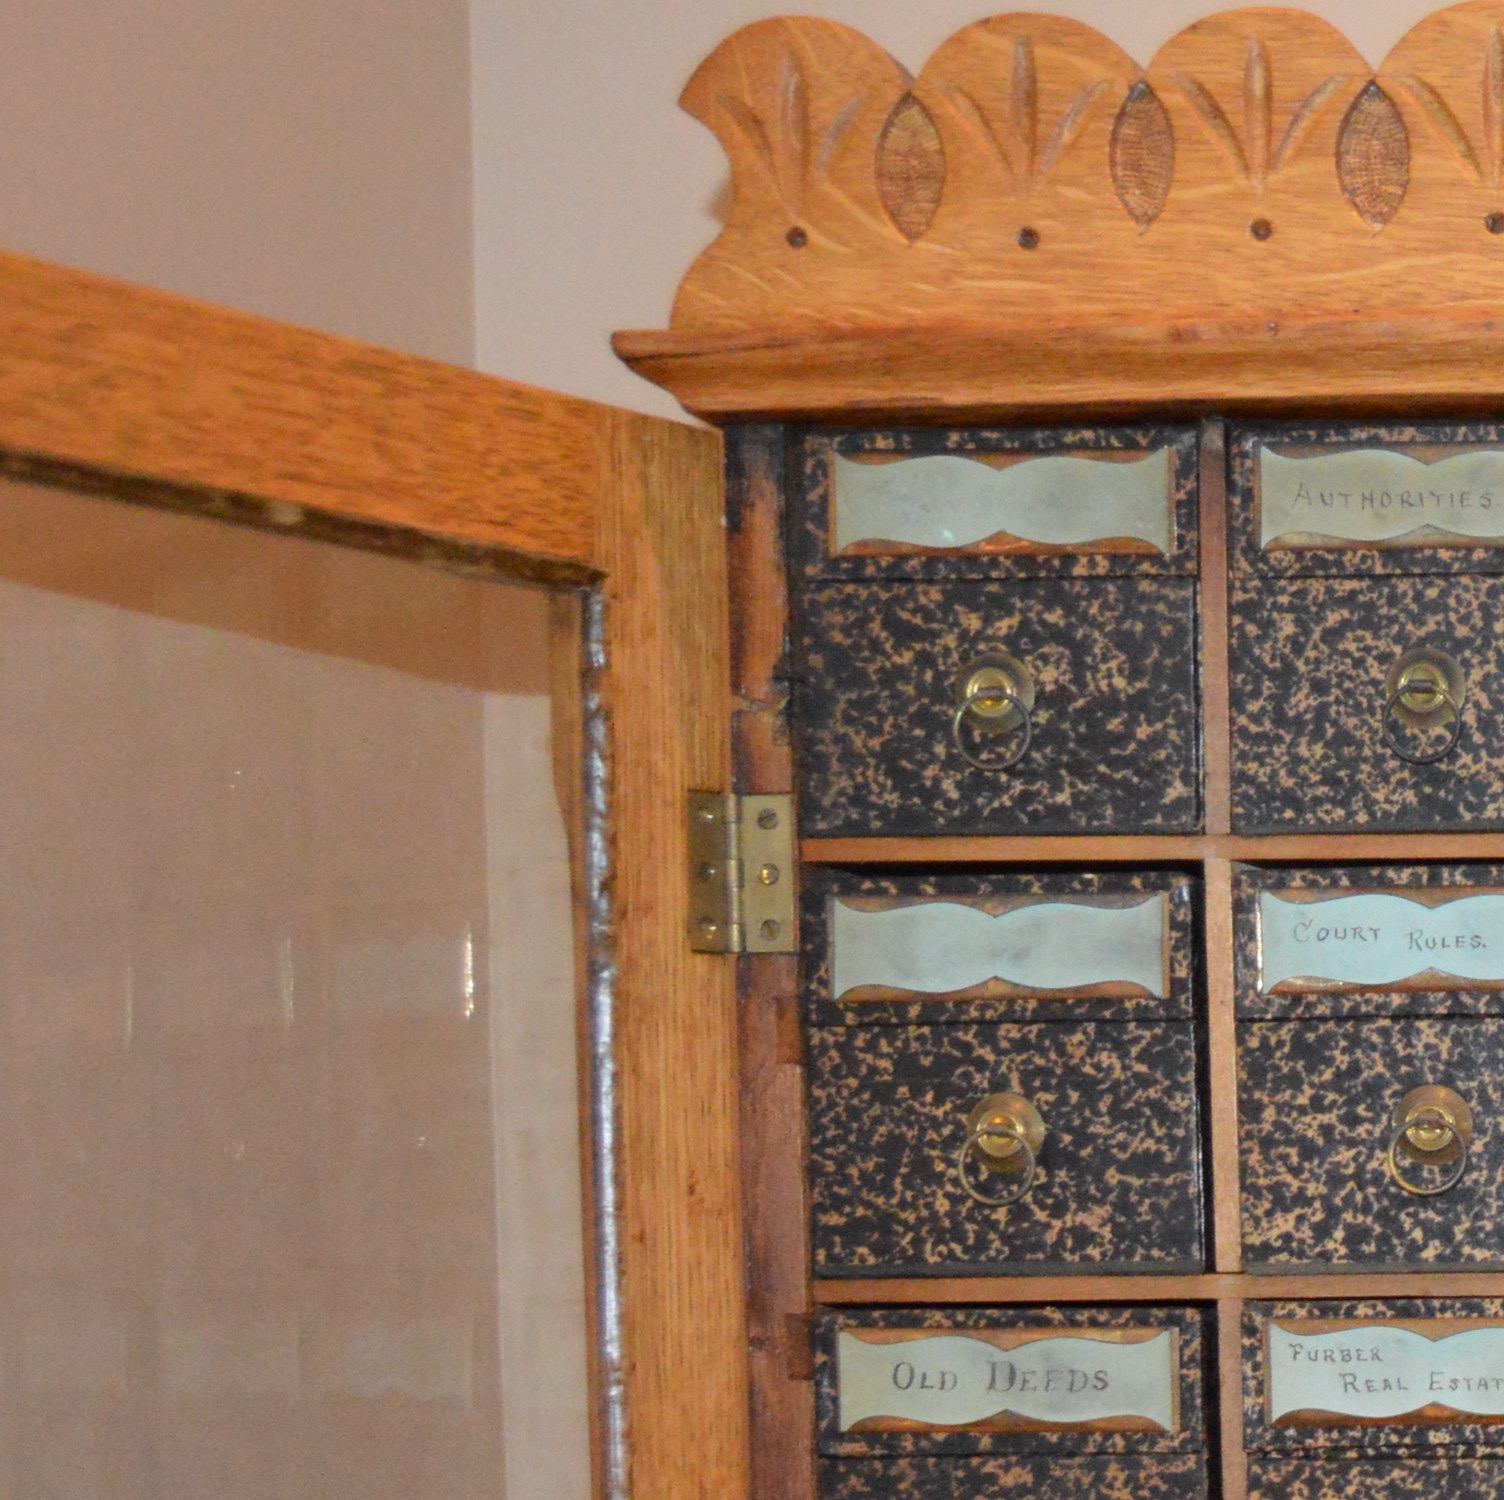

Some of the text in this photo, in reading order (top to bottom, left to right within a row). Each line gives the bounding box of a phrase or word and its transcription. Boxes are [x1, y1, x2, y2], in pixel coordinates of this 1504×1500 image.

[1291, 481, 1500, 511] AUTHORITIES.
[1291, 918, 1488, 952] COURT RULES.
[1288, 1342, 1384, 1364] FURBER
[890, 1357, 1110, 1394] OLD DEEDS
[1338, 1371, 1410, 1394] REAL
